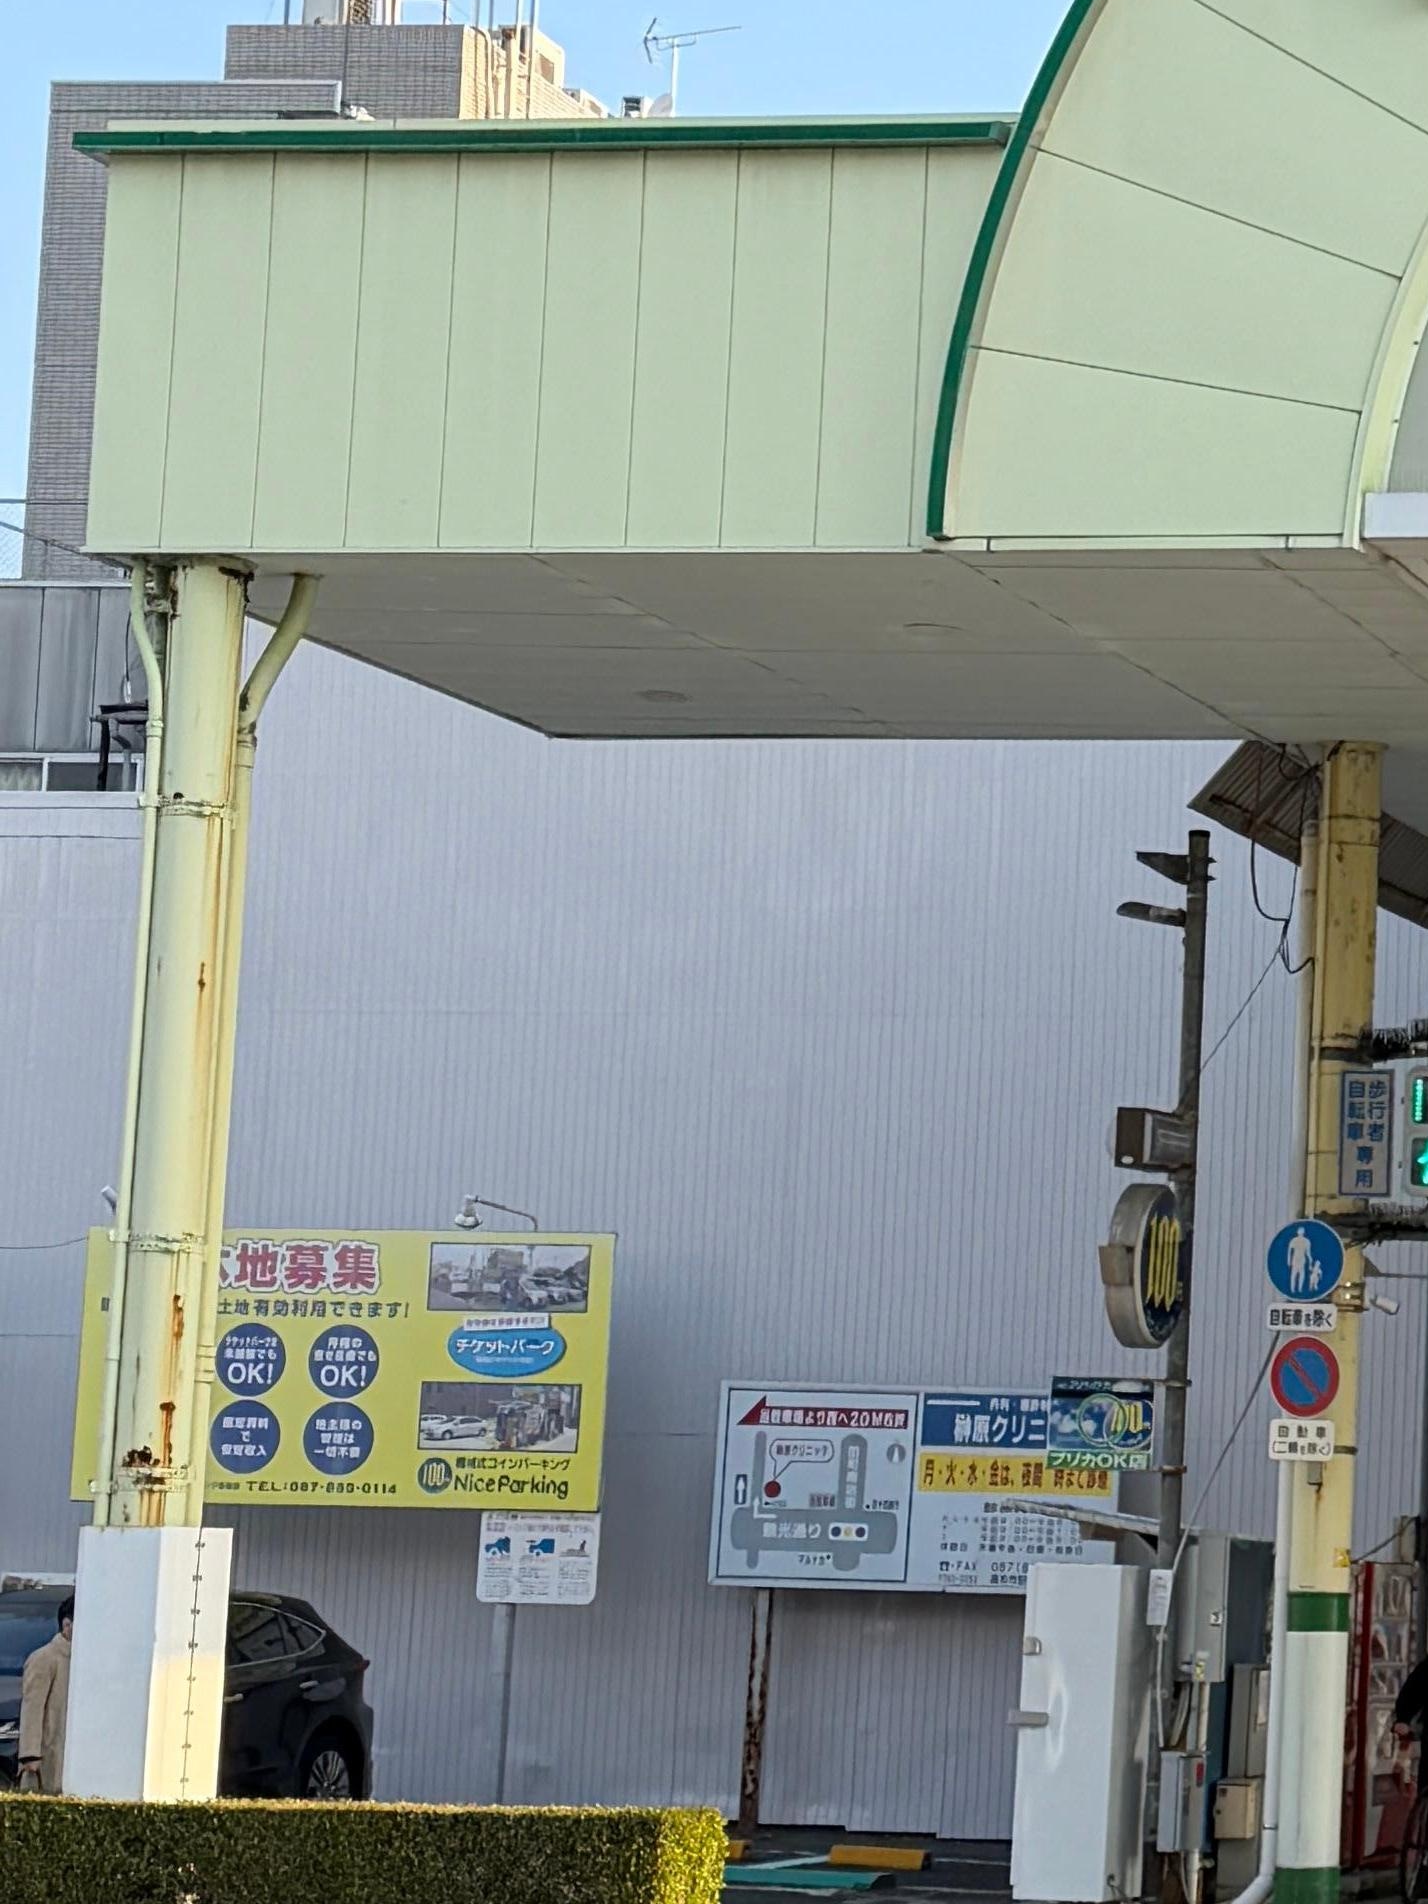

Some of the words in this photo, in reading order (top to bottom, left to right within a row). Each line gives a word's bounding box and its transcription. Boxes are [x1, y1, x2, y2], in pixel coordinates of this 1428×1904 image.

[1347, 1081, 1366, 1141] 自転車
[1367, 1080, 1387, 1142] 歩行者
[1354, 1145, 1373, 1189] 専用
[1269, 1308, 1333, 1329] 自転車を除く
[456, 1339, 556, 1356] チケットパーク
[227, 1362, 274, 1385] OK!
[320, 1365, 367, 1387] OK!
[1278, 1425, 1326, 1438] 自動車
